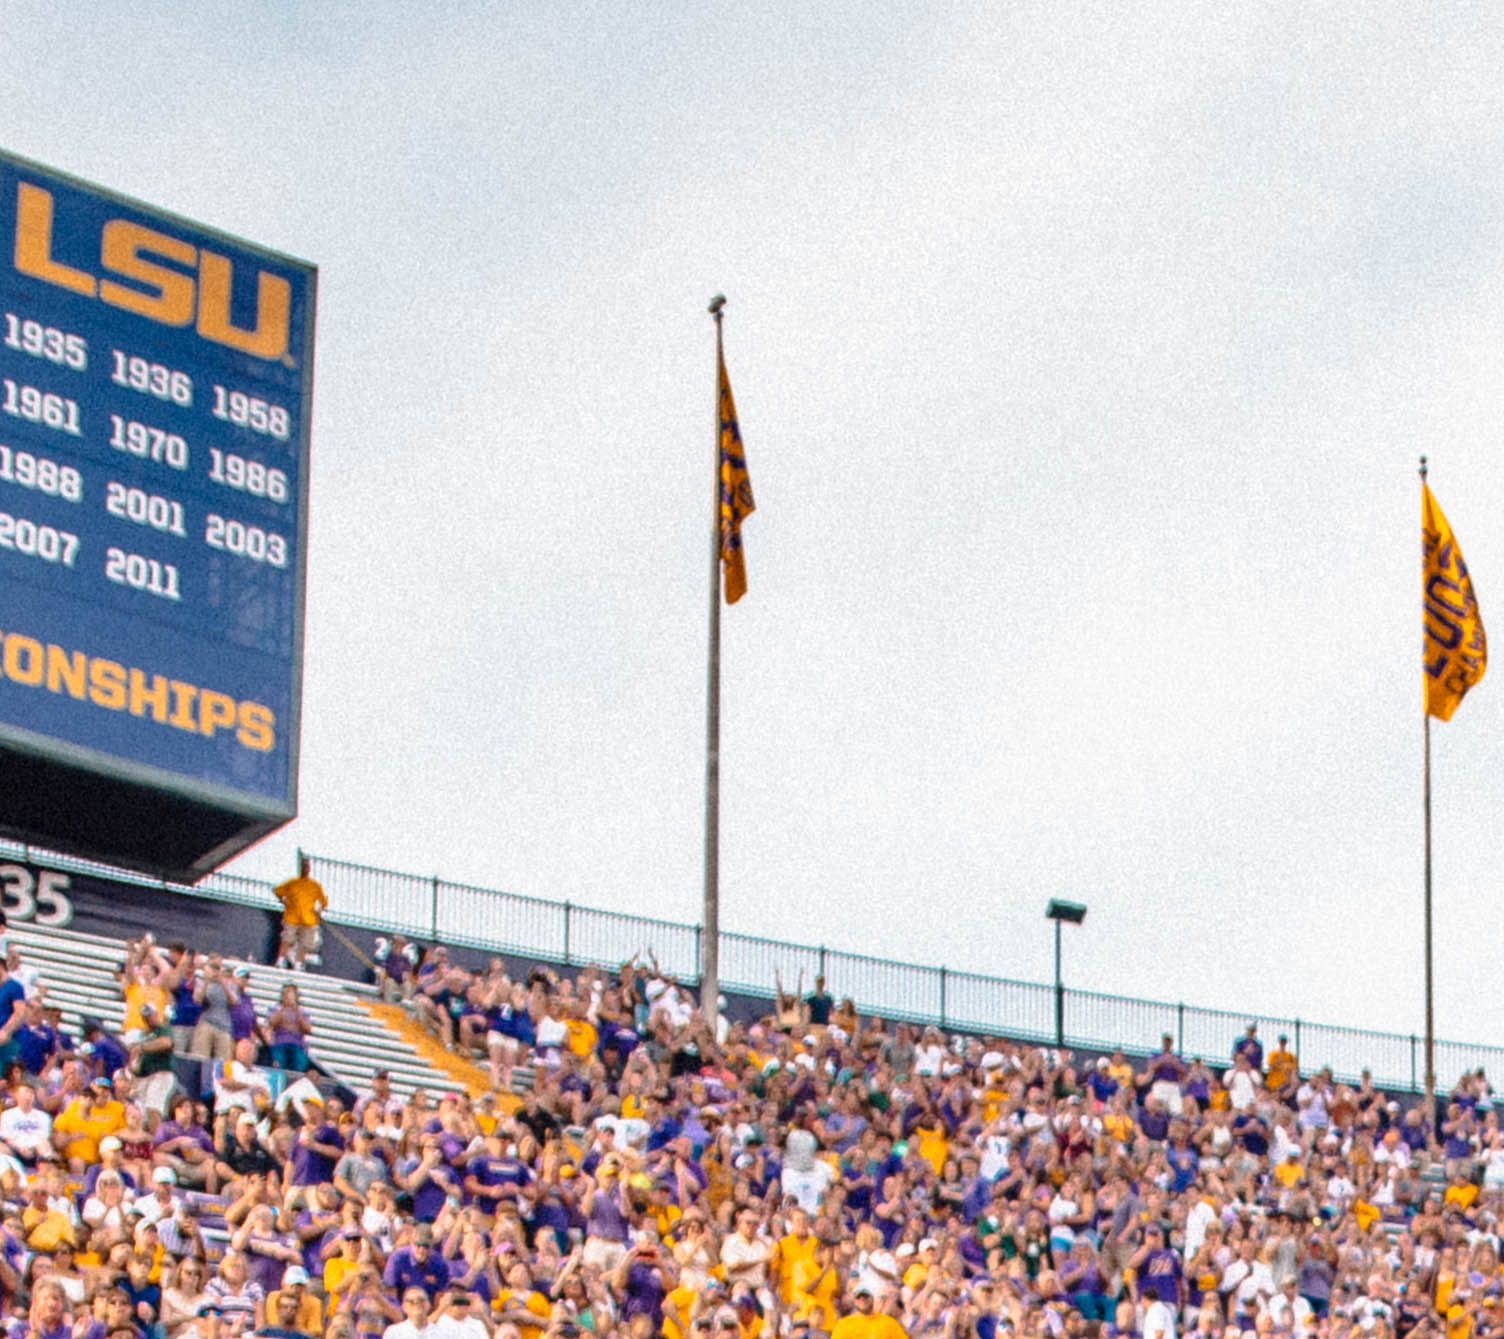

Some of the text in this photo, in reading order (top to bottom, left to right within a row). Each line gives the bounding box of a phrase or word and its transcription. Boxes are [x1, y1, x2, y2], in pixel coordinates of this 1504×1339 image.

[15, 182, 292, 360] LSU
[4, 312, 292, 441] 1935 1936 1958
[3, 378, 290, 506] 1961 1970 1986
[105, 547, 182, 601] 2011
[107, 481, 188, 539] 2001
[206, 513, 289, 570] 2003
